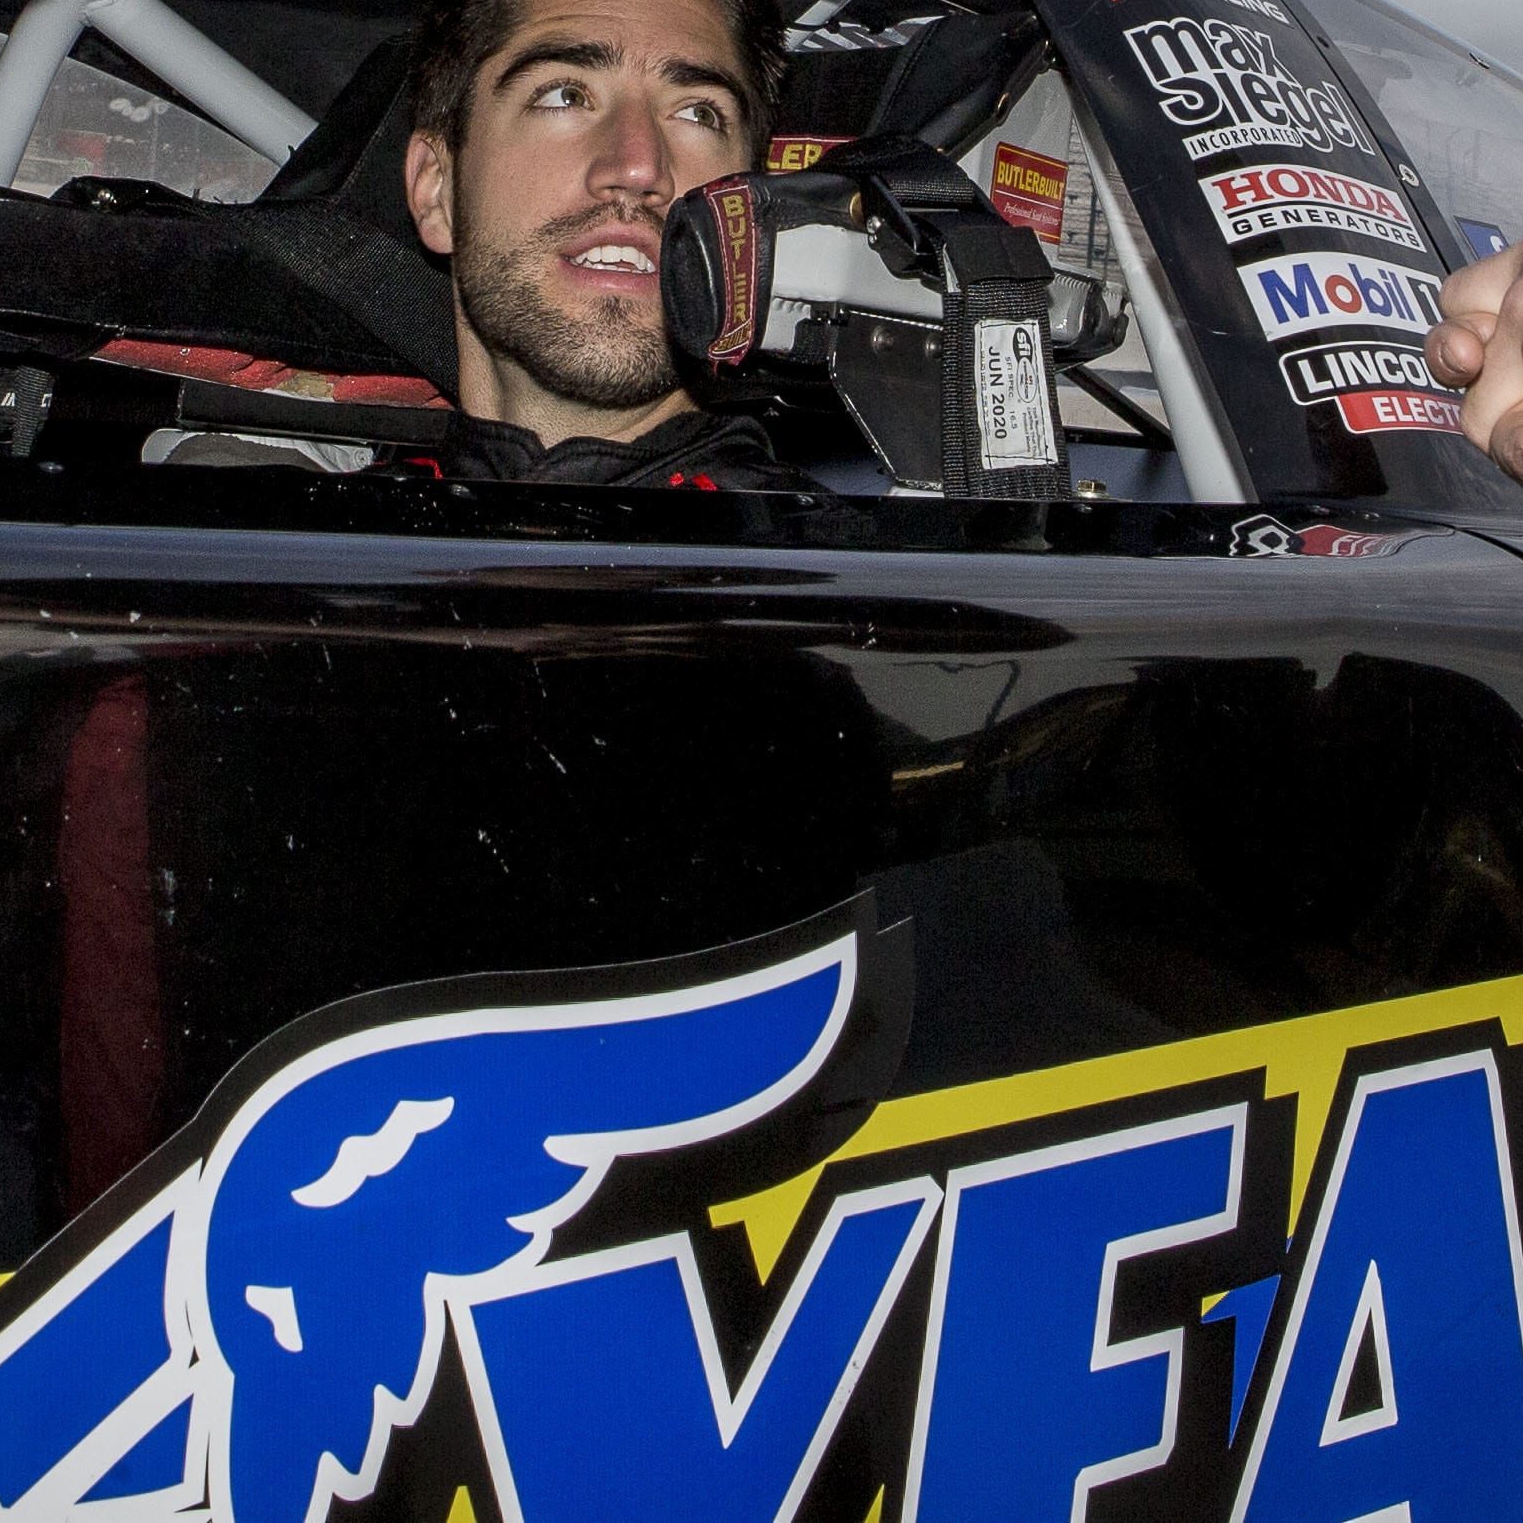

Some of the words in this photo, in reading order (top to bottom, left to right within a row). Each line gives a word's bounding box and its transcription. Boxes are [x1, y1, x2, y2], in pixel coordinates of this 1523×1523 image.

[1123, 17, 1298, 83] max
[1188, 127, 1301, 157] INCORPORATED
[996, 160, 1065, 201] BUTLERBUILT
[1210, 169, 1407, 223] HONDA
[1231, 208, 1422, 248] GENERATORS
[721, 194, 747, 324] BUTLER
[1261, 262, 1417, 324] Mobil
[1413, 280, 1444, 325] 1
[988, 345, 1005, 388] JUN
[1016, 331, 1032, 357] sfi
[991, 393, 1008, 440] 2020
